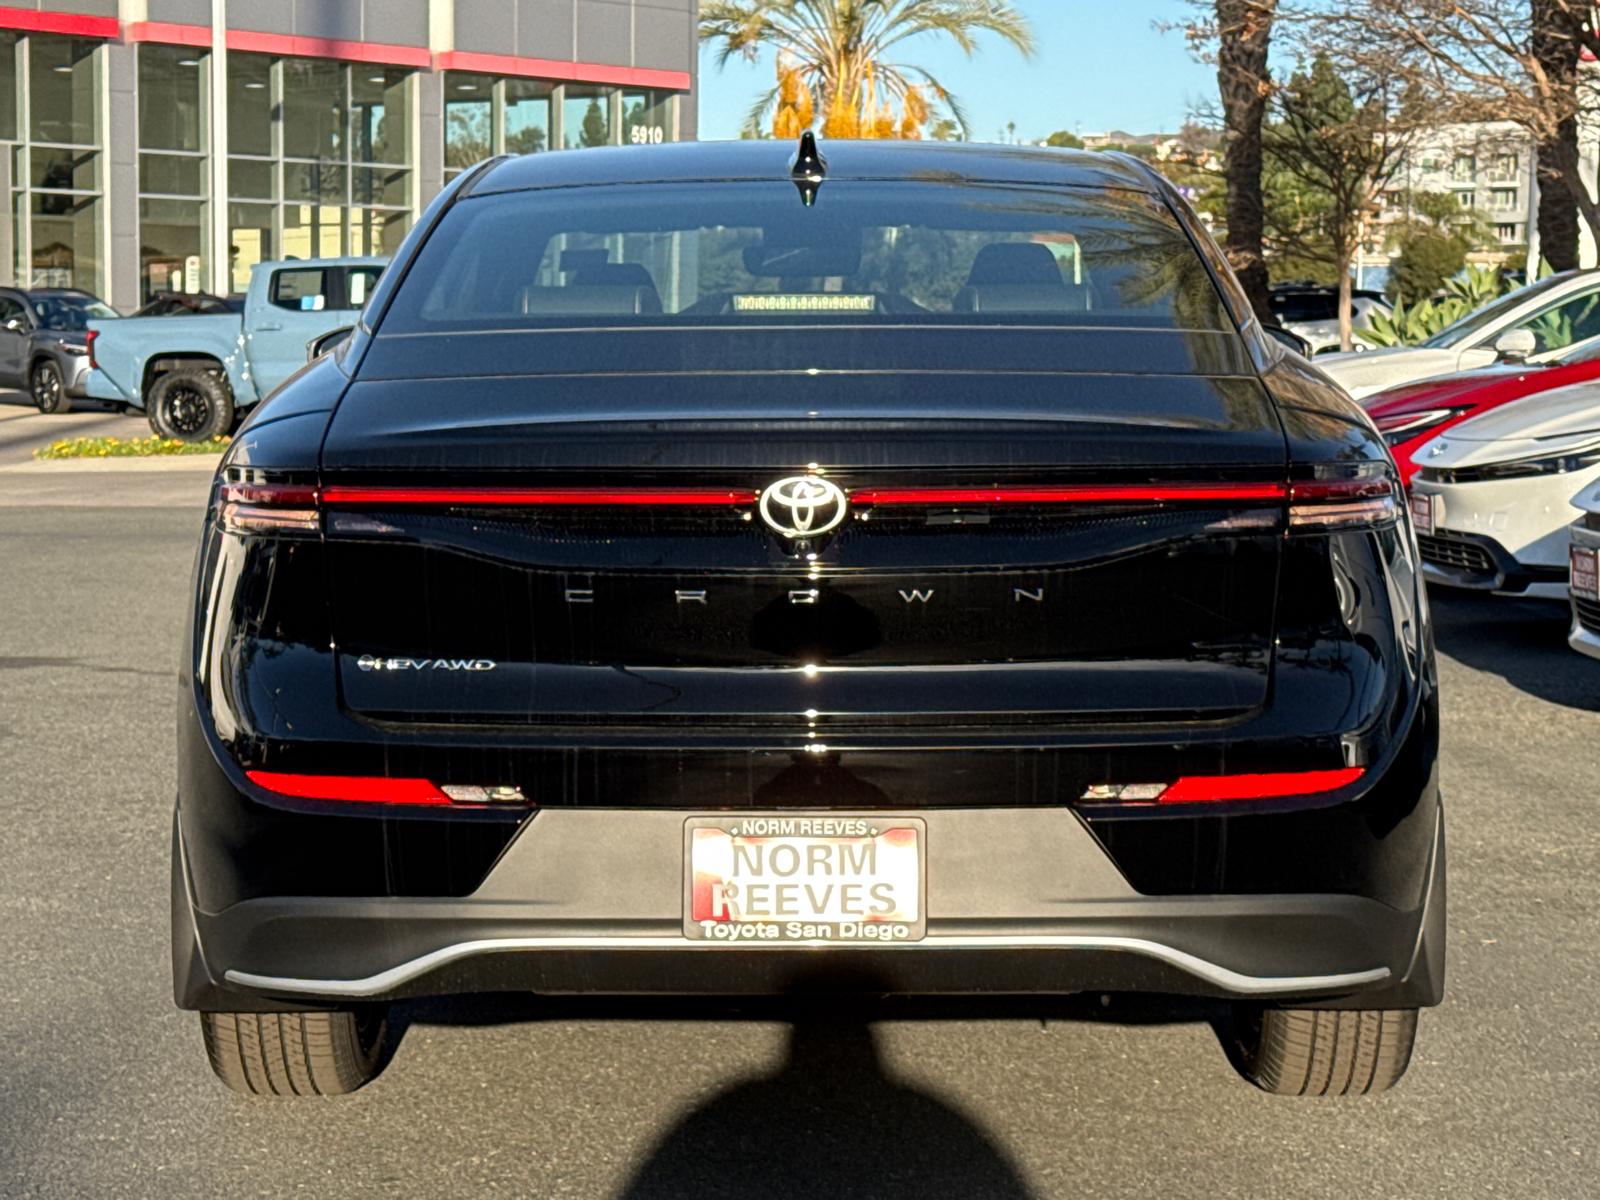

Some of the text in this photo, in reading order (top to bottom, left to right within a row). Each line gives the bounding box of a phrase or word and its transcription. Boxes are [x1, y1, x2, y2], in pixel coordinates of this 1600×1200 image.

[631, 125, 663, 144] 5910
[564, 588, 1044, 604] CROWN
[432, 658, 498, 671] AWD
[742, 819, 867, 835] NORM REEVES
[732, 843, 877, 877] NORM
[712, 882, 897, 917] REEVES
[700, 920, 909, 941] Toyota San Diego
